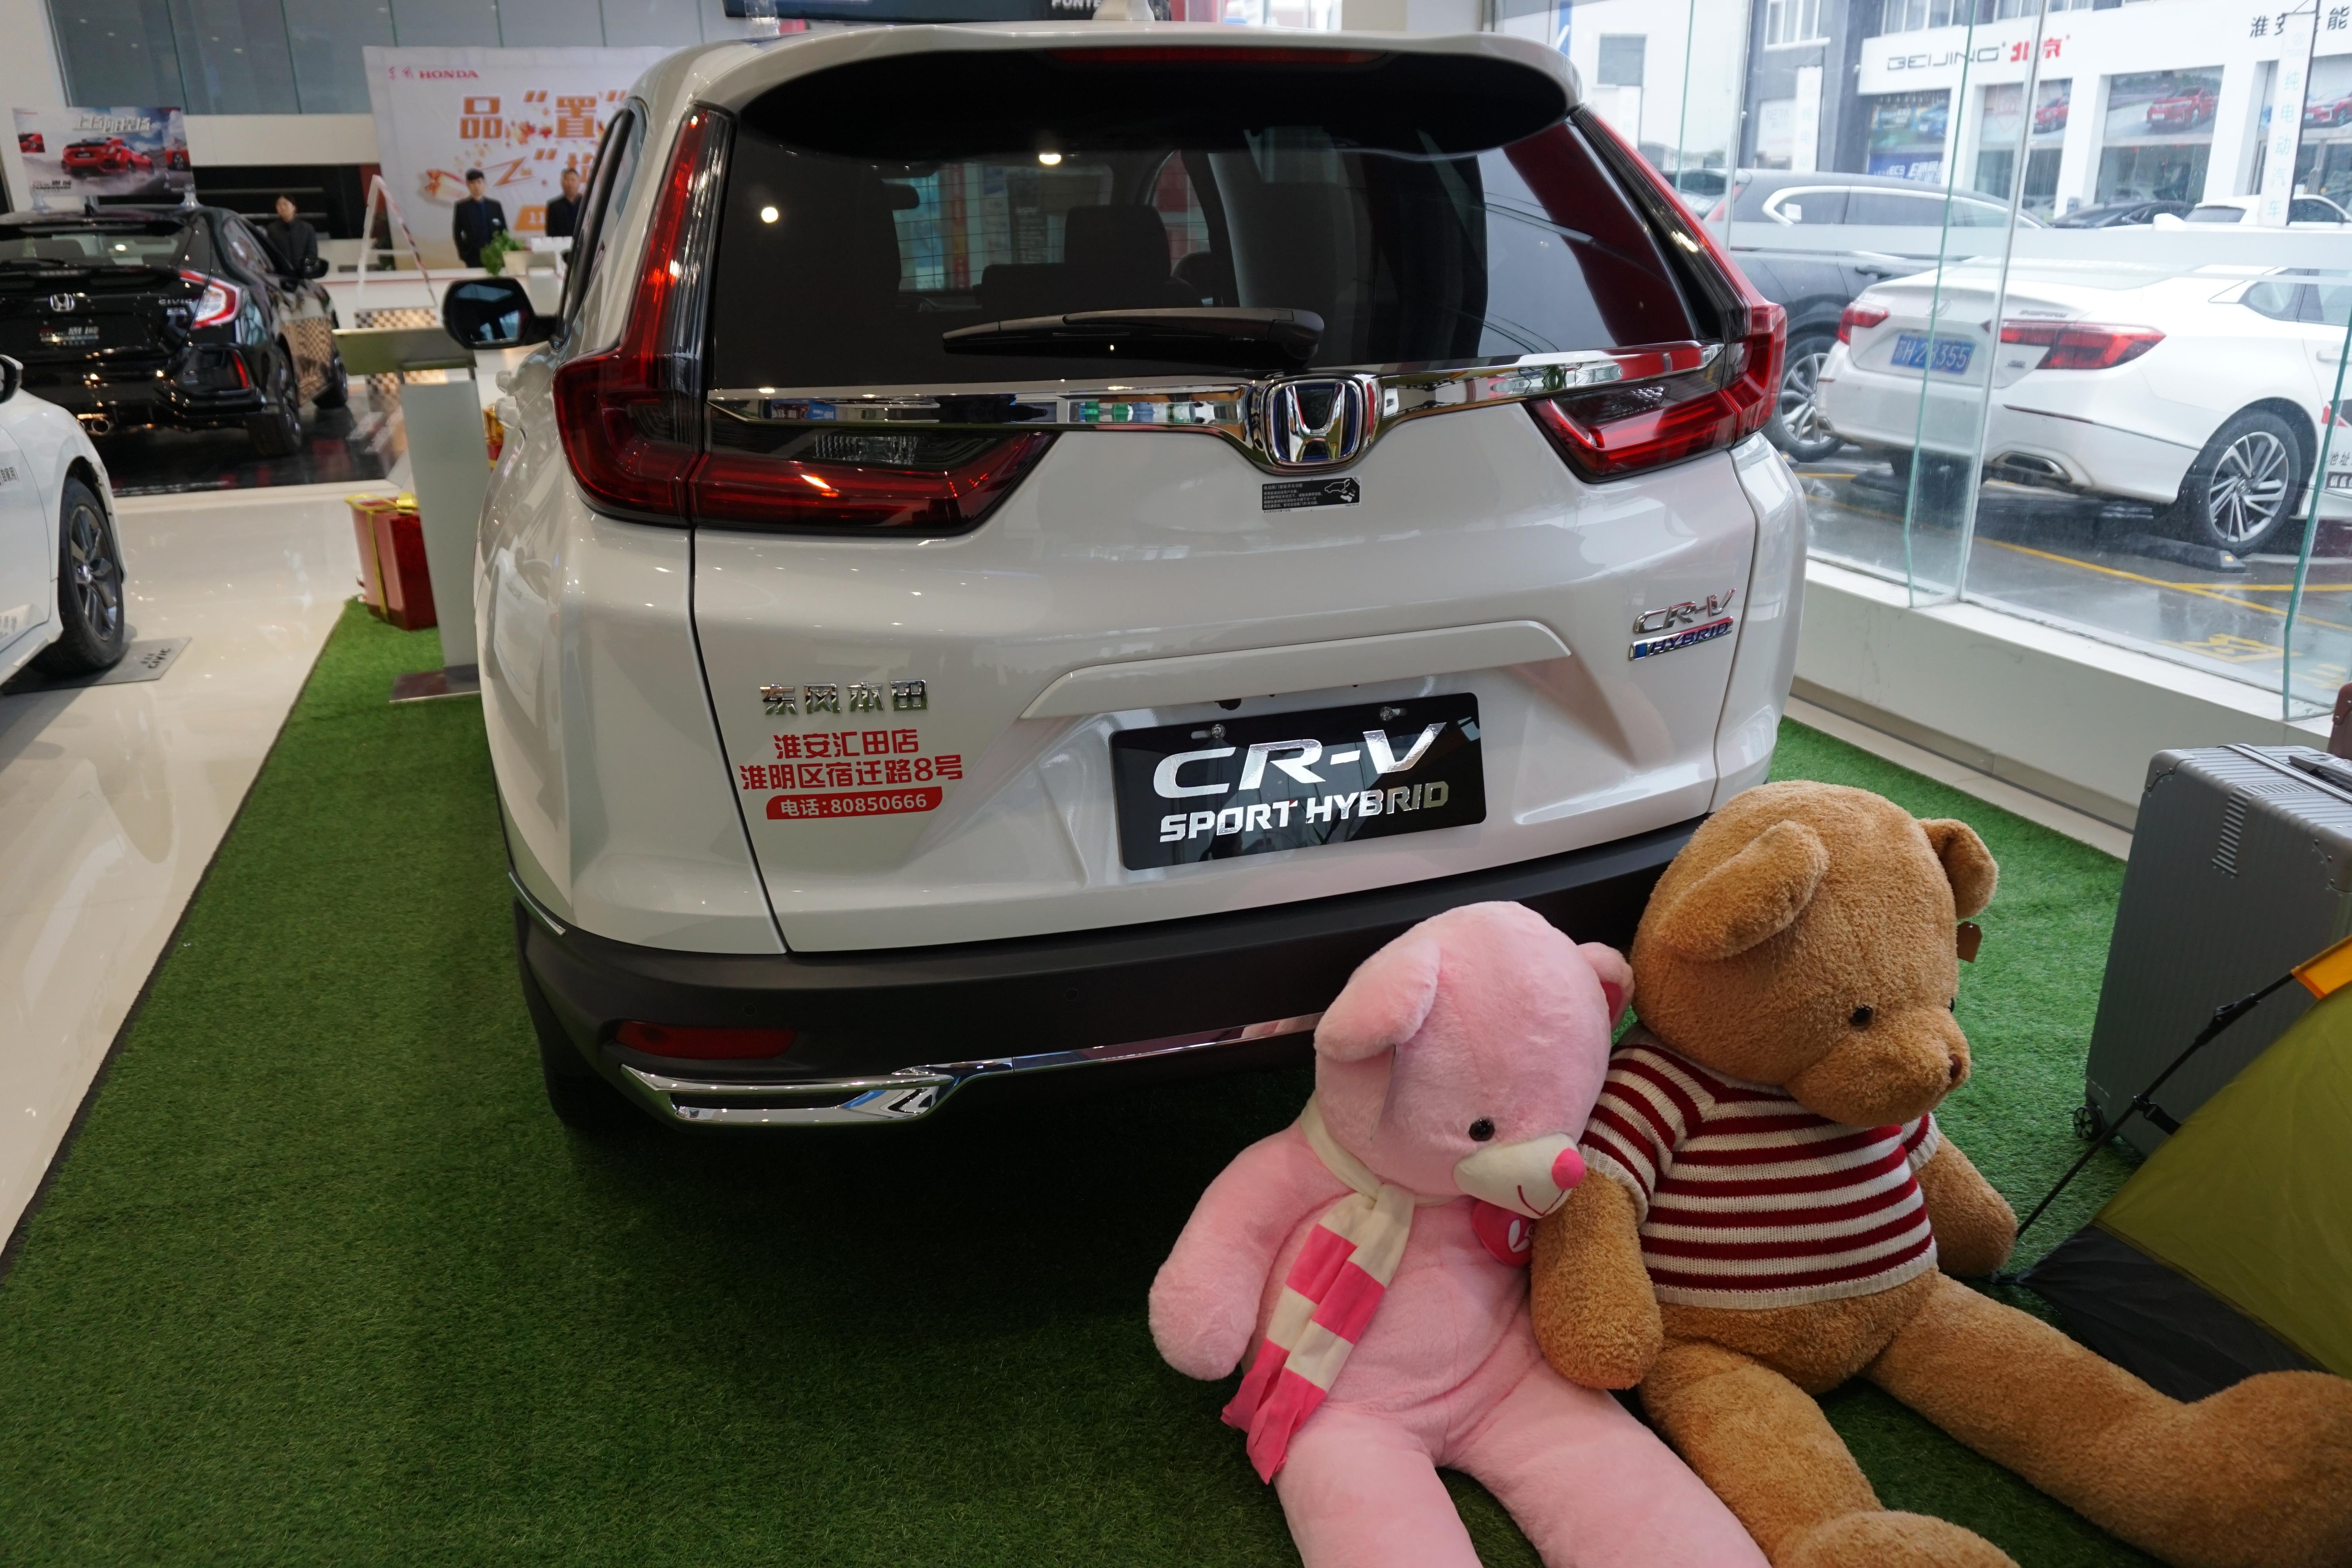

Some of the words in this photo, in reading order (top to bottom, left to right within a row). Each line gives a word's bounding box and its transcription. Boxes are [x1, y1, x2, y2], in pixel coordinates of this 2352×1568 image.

[419, 69, 479, 79] HONDA
[2267, 70, 2300, 216] 纯电动汽车
[1633, 588, 1737, 634] CR-V
[1649, 622, 1729, 655] HYBRID
[759, 679, 929, 715] 东风本田
[773, 729, 919, 759] 淮安汇田店
[1153, 722, 1447, 798] CR-V
[739, 755, 963, 790] 淮阴区宿迁路8号
[780, 793, 927, 817] 电话:80850666
[1159, 800, 1298, 843] SPORT
[1305, 780, 1449, 824] HYBRID
